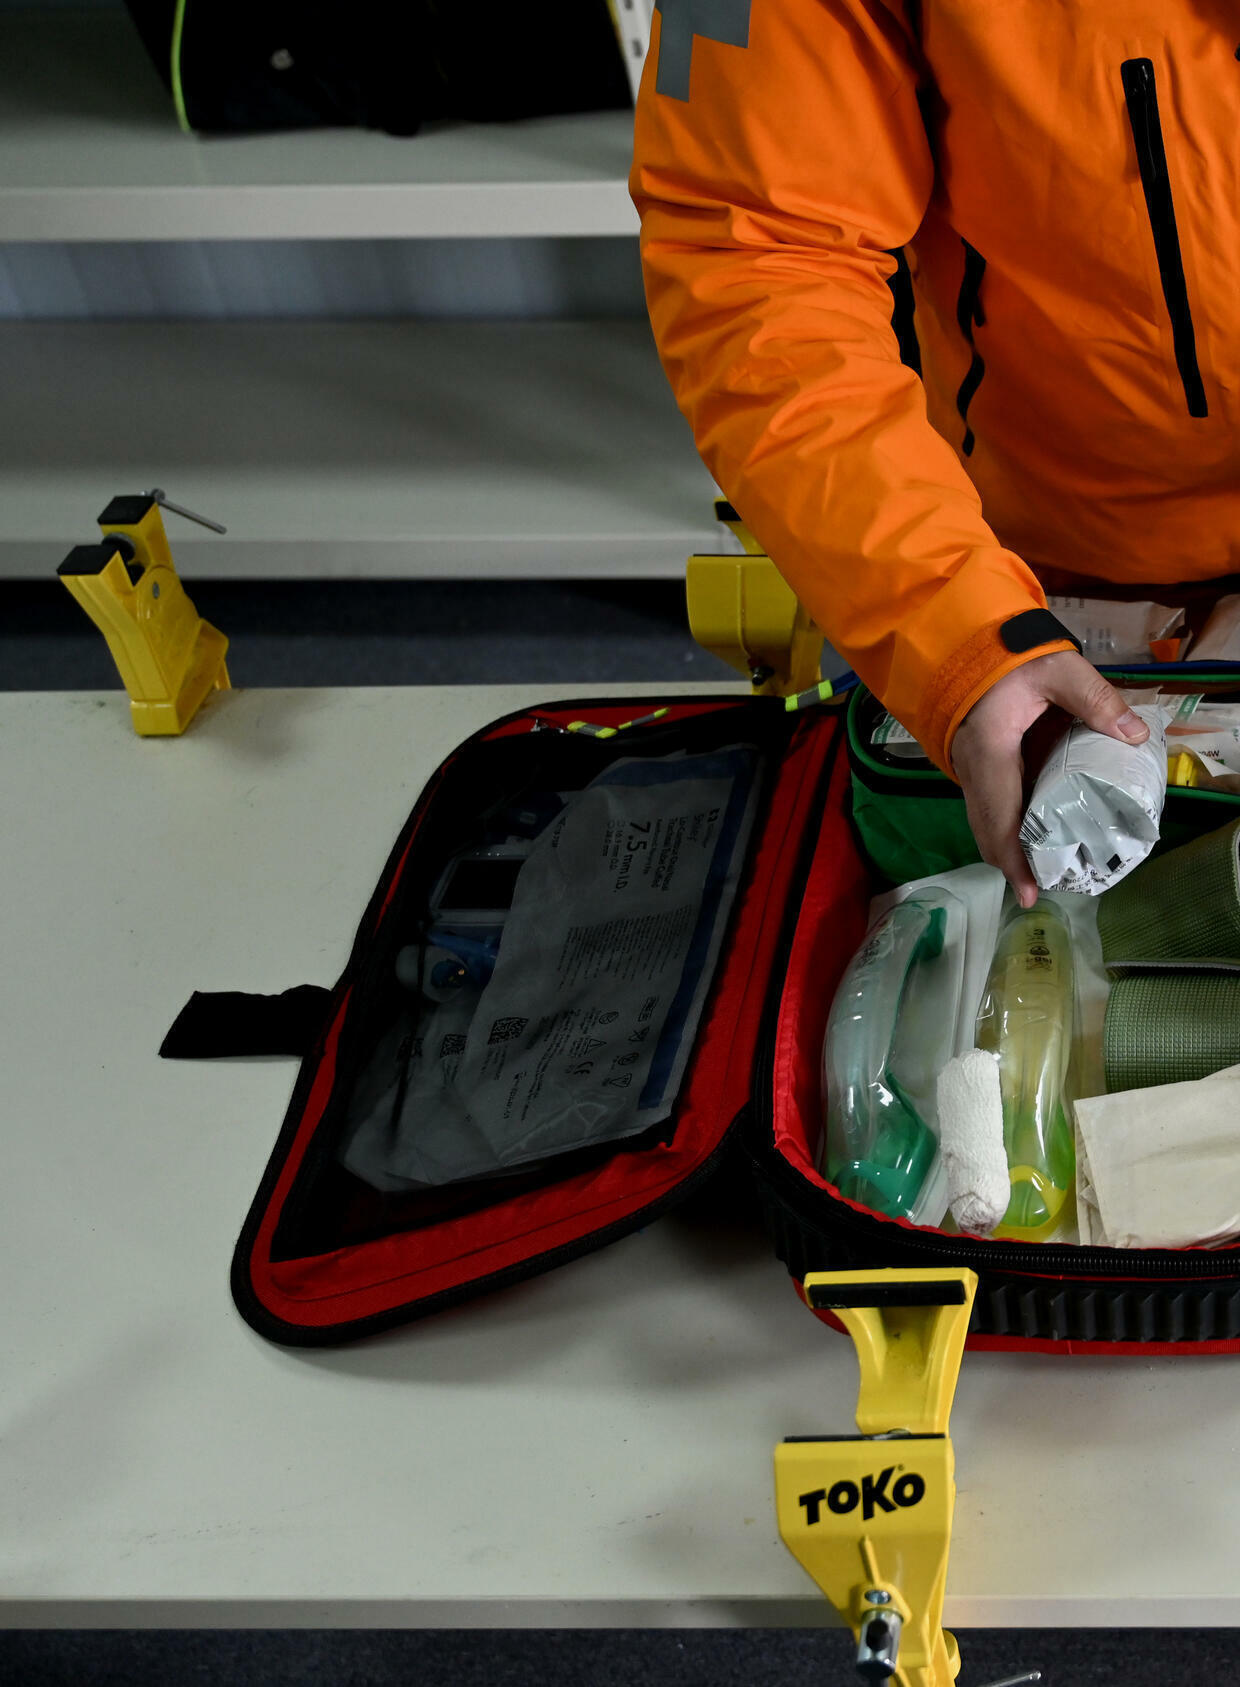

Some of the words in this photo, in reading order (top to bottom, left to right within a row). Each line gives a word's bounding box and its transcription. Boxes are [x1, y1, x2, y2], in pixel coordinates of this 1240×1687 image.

[626, 820, 651, 852] 7.5
[619, 854, 633, 874] mm
[799, 1465, 926, 1526] TOKO
